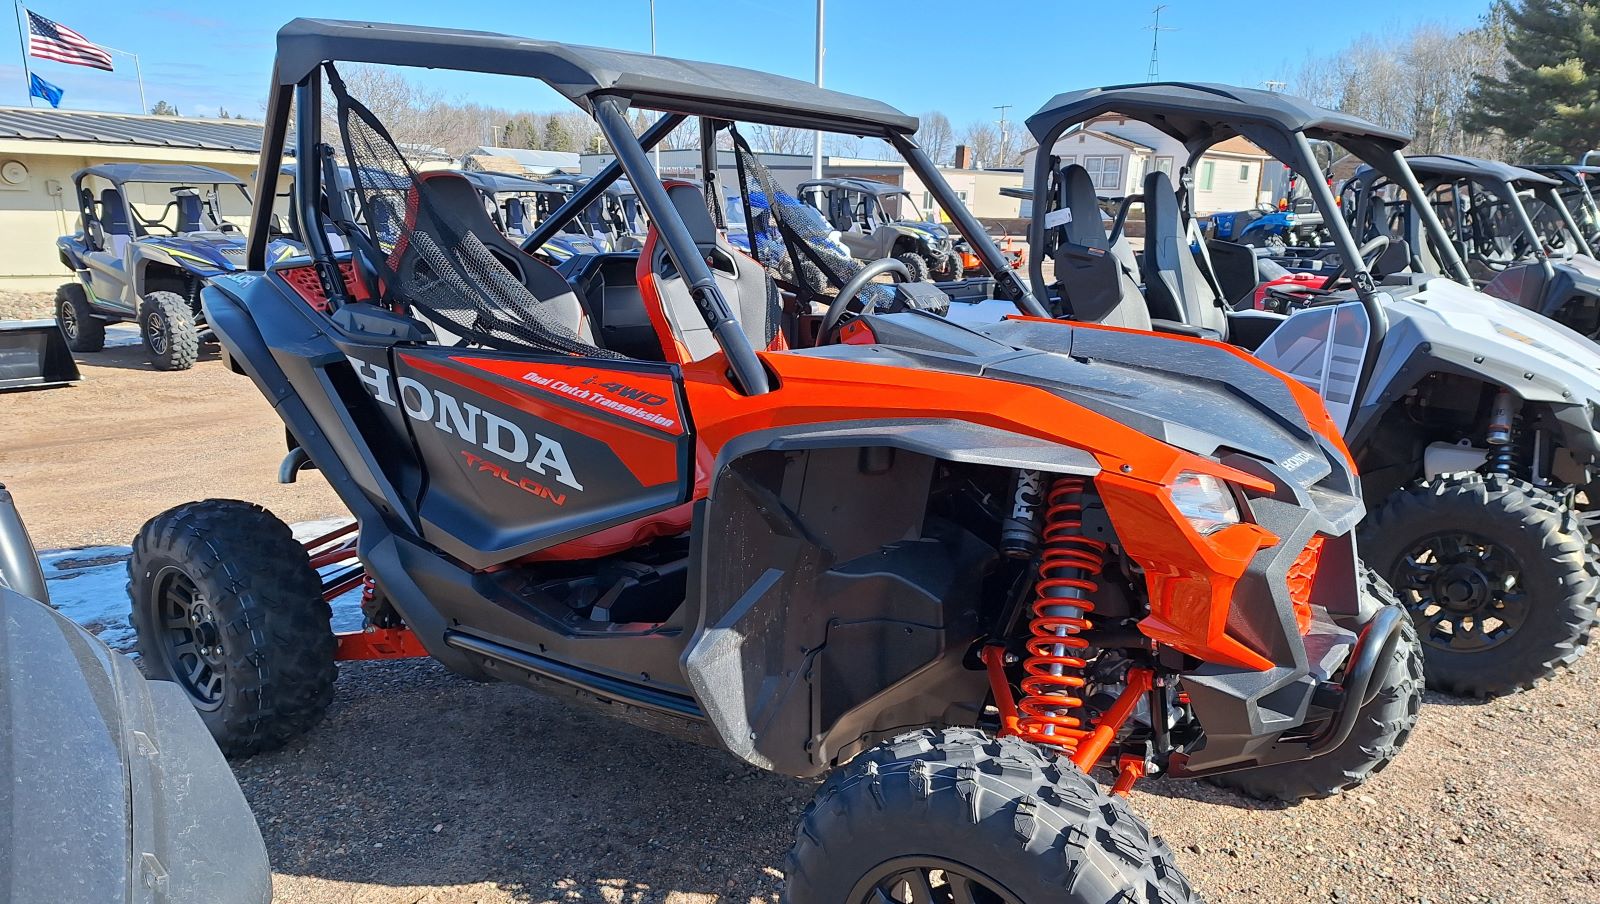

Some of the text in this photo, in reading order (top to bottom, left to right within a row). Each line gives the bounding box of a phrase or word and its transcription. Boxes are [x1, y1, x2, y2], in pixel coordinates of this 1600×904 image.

[346, 354, 583, 492] HONDA
[522, 371, 675, 428] Dual Clutch Transmission
[461, 450, 567, 506] TALON
[1281, 450, 1315, 472] HONDA
[1012, 469, 1041, 521] FOX
